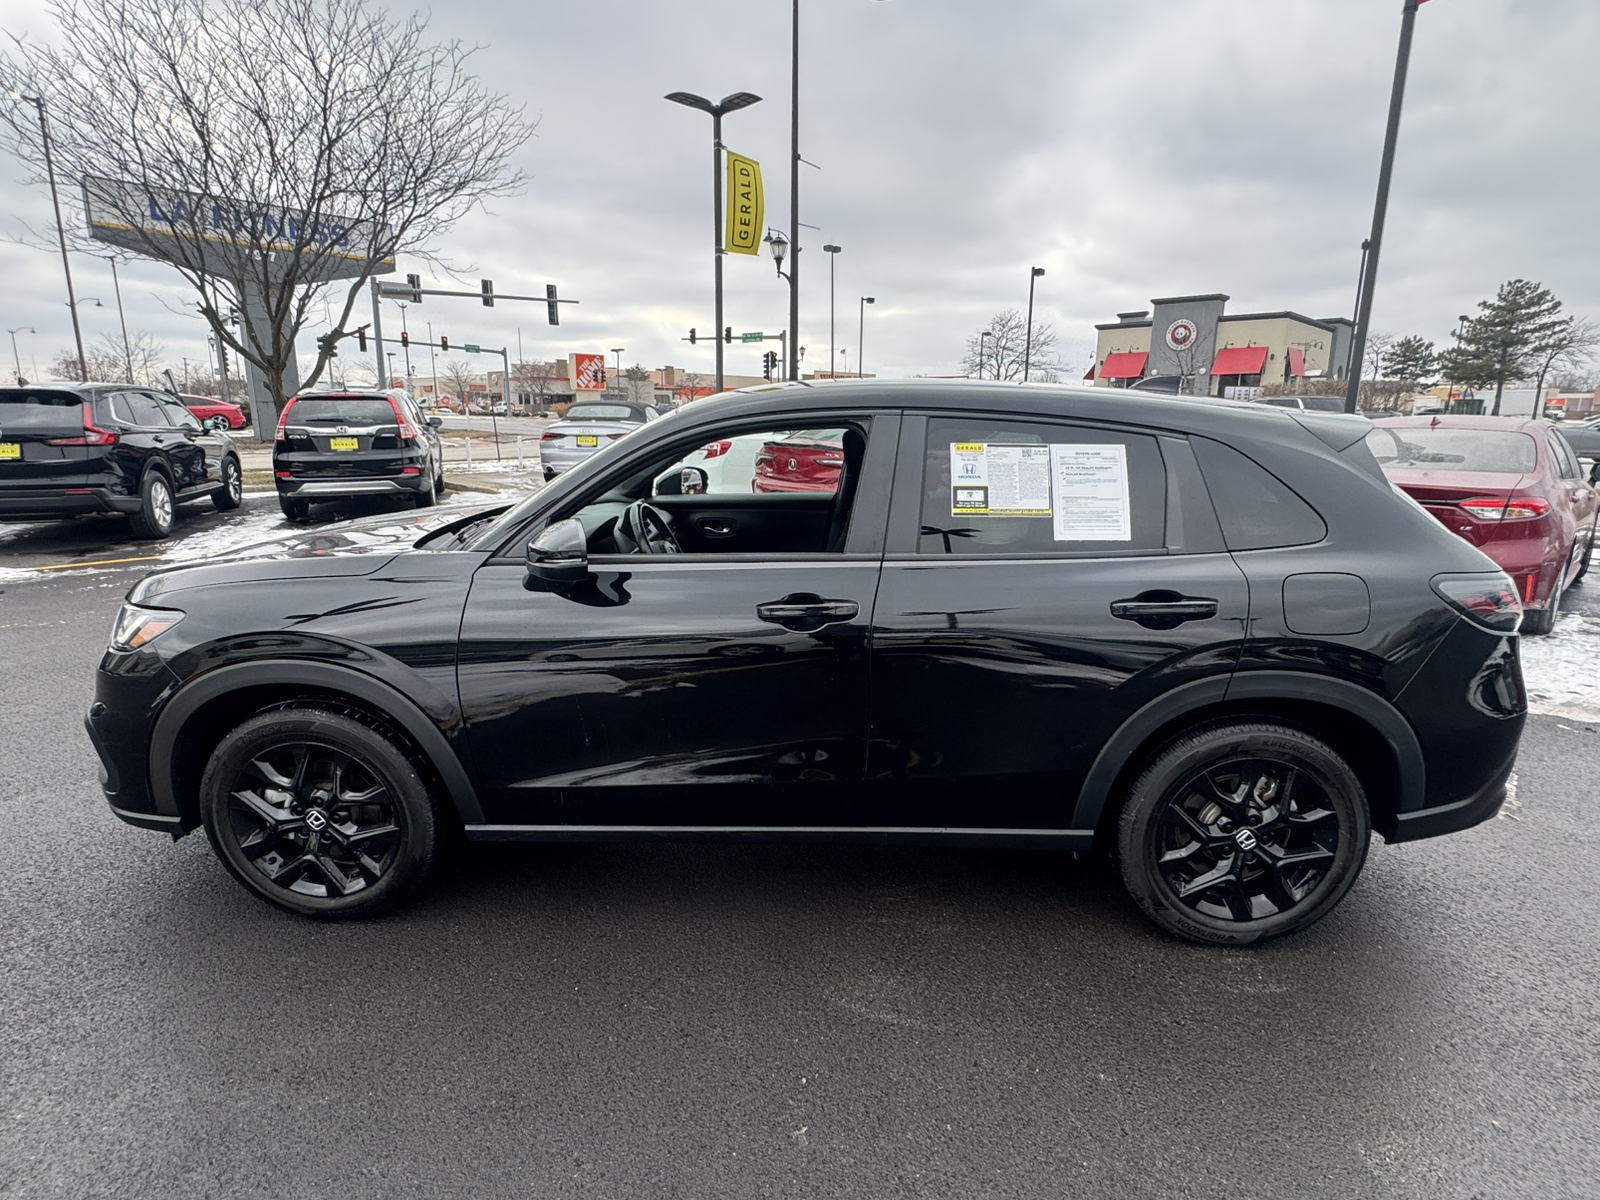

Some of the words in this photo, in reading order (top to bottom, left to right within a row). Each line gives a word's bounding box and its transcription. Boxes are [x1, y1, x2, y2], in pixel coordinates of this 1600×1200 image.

[150, 201, 190, 223] LA
[738, 167, 752, 241] GERALD
[577, 356, 604, 389] HOME
[578, 358, 591, 372] THE
